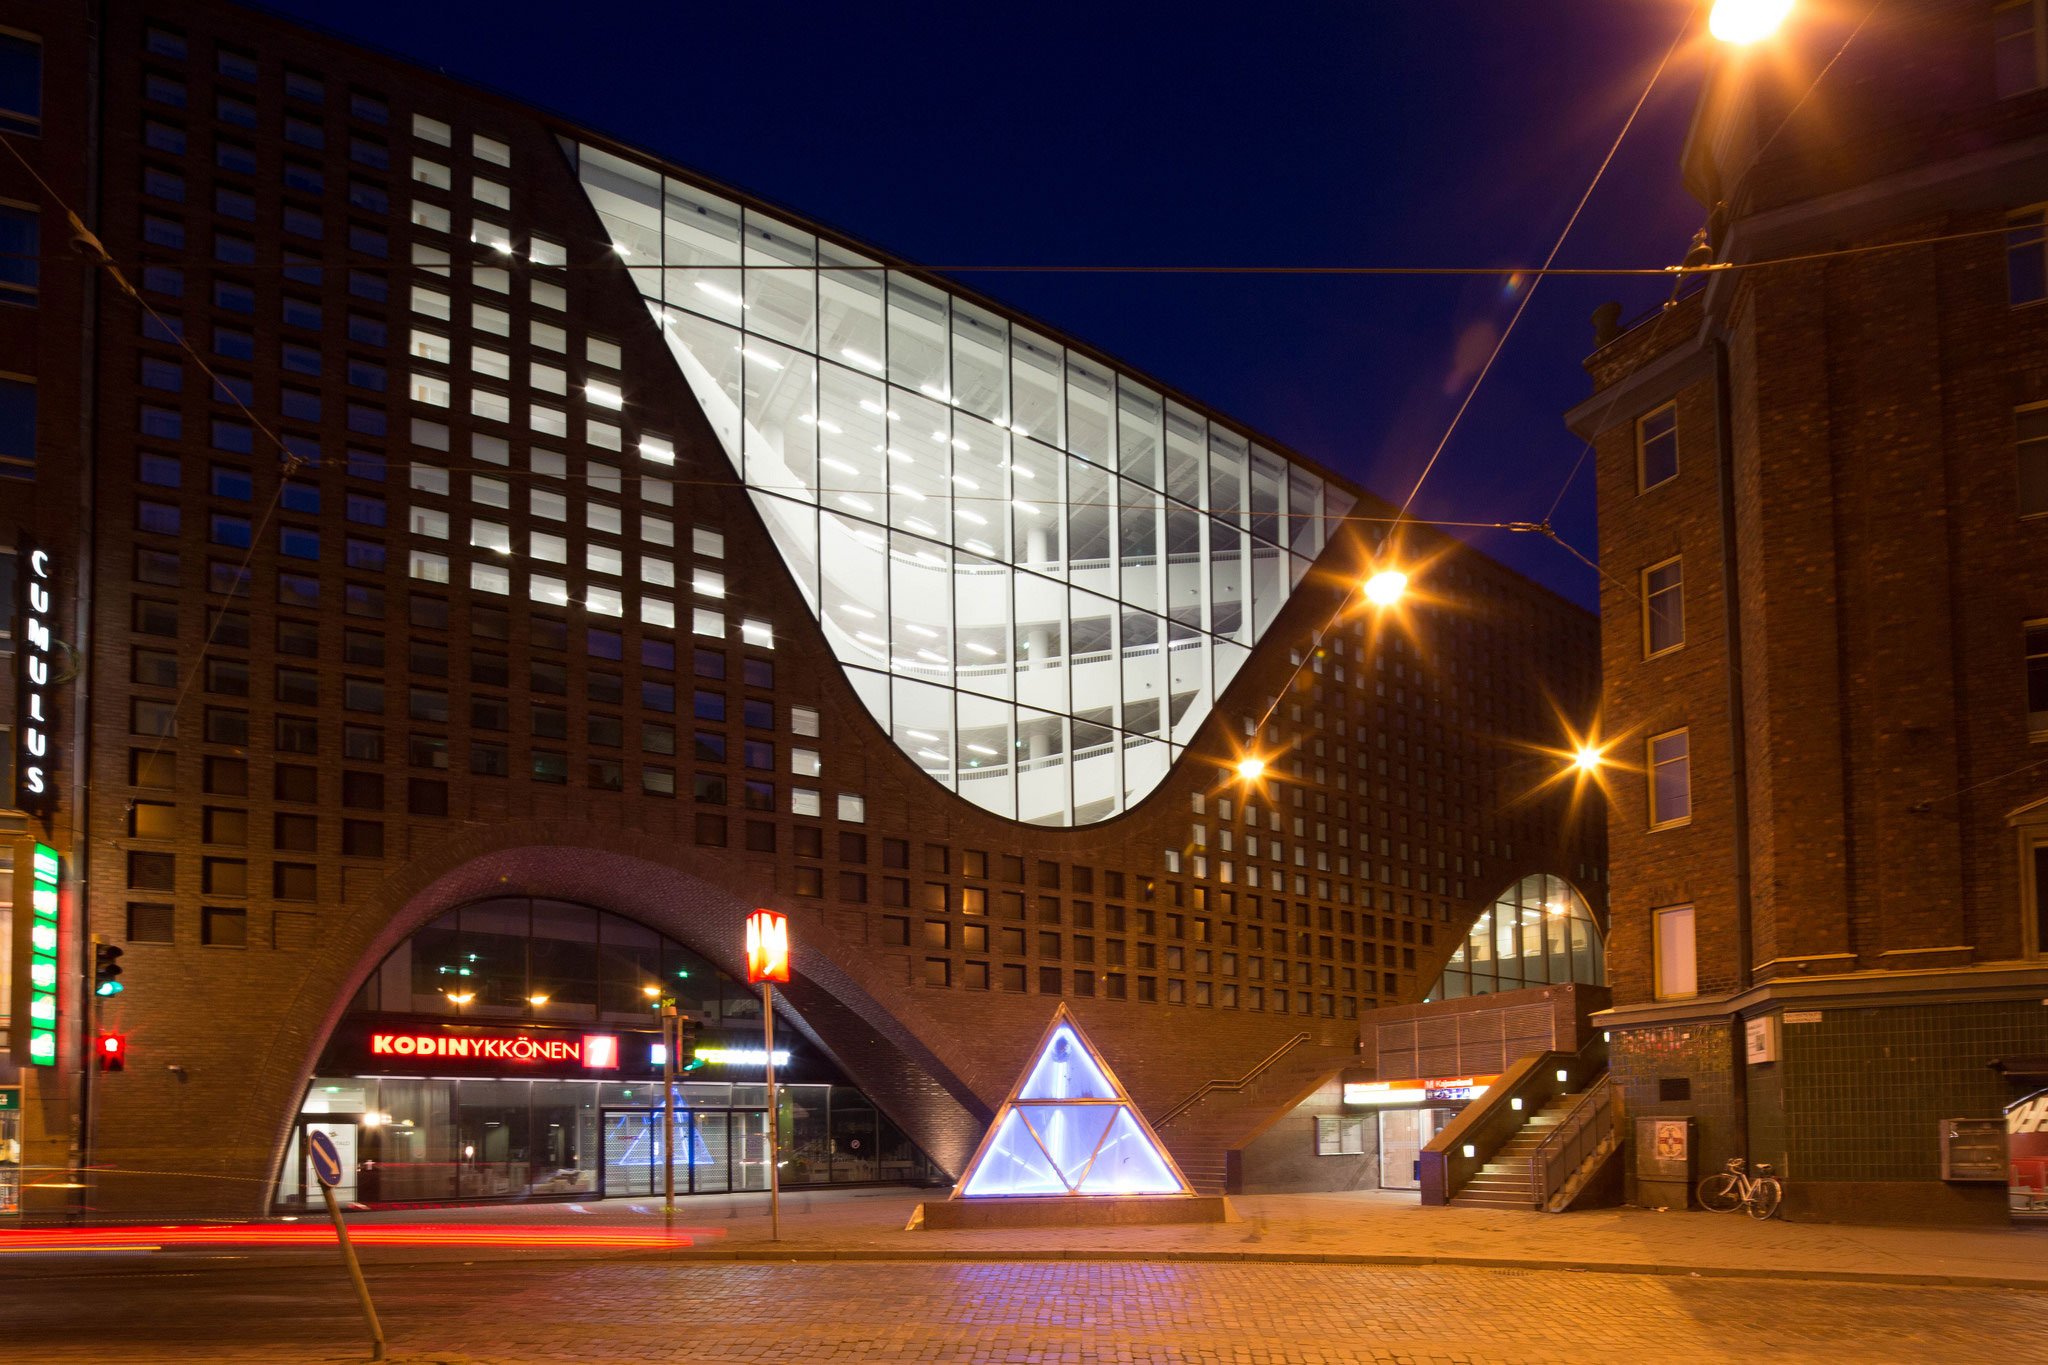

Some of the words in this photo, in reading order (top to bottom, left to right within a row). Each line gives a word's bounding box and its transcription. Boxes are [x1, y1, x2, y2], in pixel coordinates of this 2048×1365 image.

[27, 549, 49, 794] CUMULUS
[373, 1034, 580, 1060] KODINYKKÖNEN
[588, 1036, 613, 1067] 1
